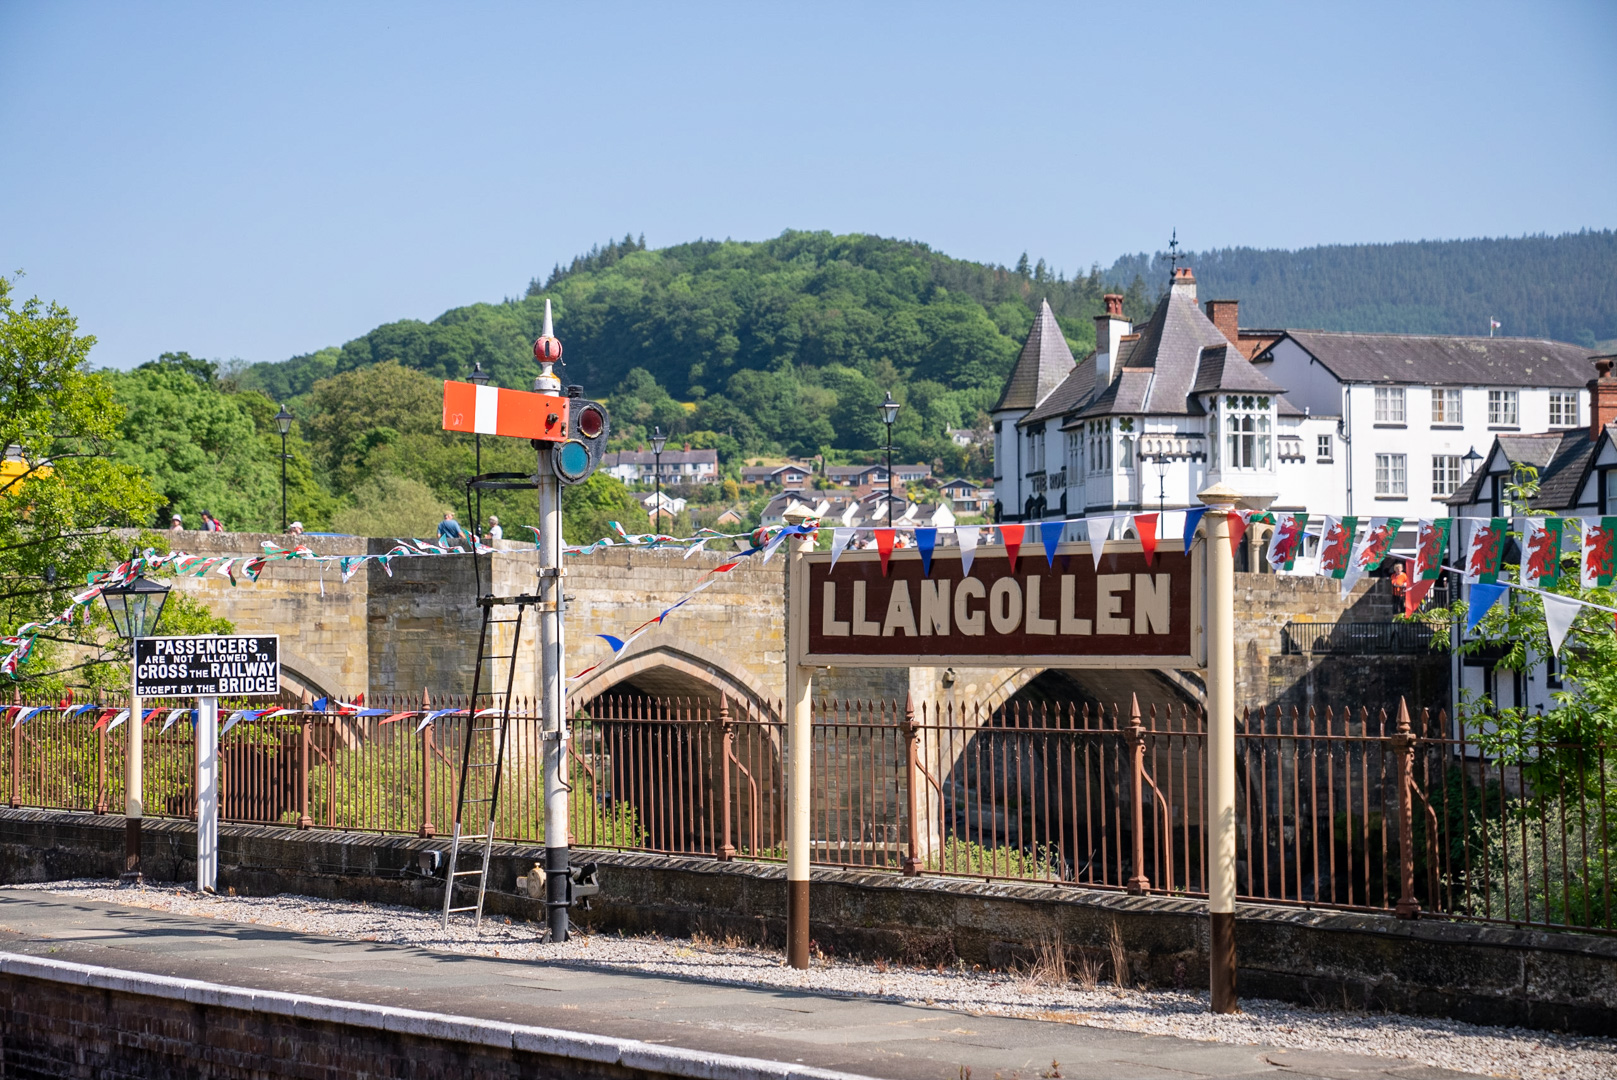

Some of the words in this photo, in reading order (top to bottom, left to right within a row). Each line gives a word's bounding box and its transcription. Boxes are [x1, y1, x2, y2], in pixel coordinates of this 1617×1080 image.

[1031, 476, 1048, 492] THE
[822, 573, 1171, 637] LLANGOLLEN
[155, 639, 257, 655] PASSENGERS
[145, 655, 166, 664] ARE
[173, 655, 194, 663] NOT
[200, 653, 248, 662] ALLOWED
[256, 653, 268, 661] TO
[138, 664, 188, 679] CROSS
[189, 669, 209, 678] THE
[210, 662, 276, 678] RAILWAY
[138, 685, 177, 694] EXCEPT
[180, 685, 193, 694] BY
[196, 684, 216, 693] THE
[219, 677, 276, 692] BRIDGE
